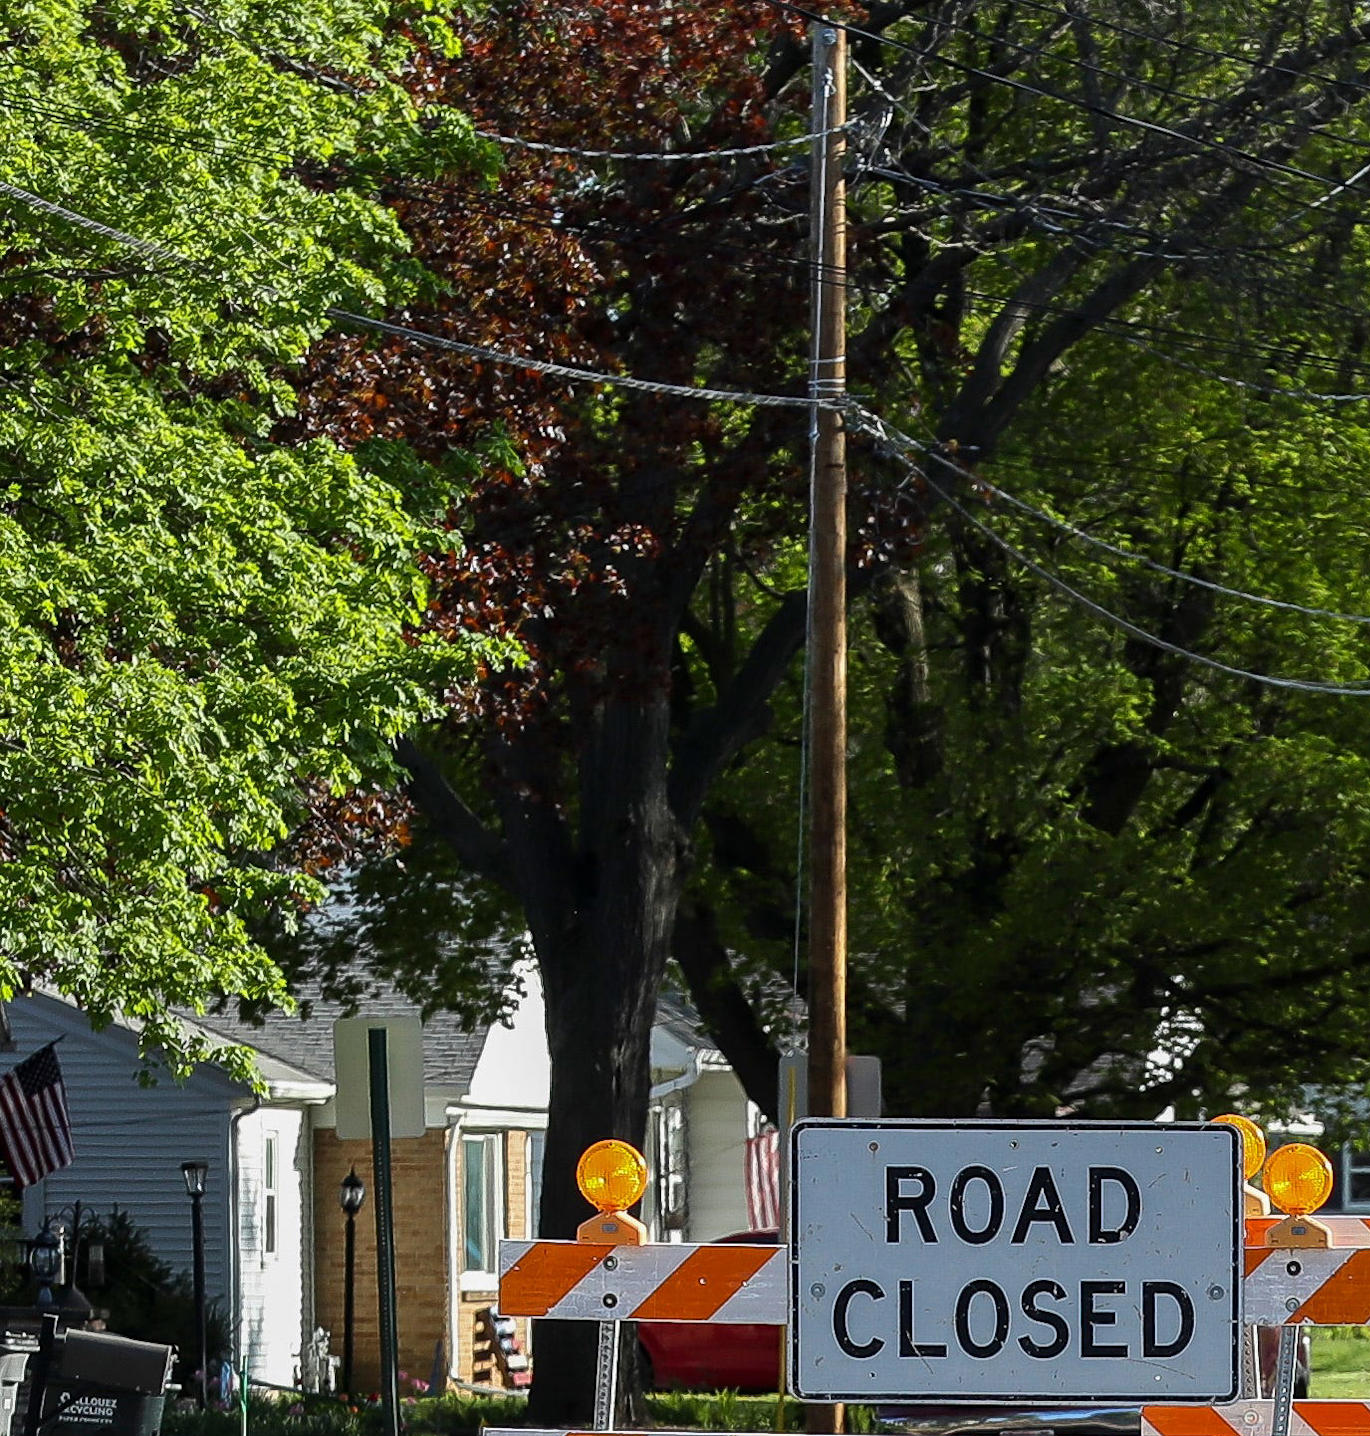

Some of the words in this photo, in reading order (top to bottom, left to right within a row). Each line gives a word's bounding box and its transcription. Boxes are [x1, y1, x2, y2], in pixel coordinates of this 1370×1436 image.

[885, 1165, 1141, 1245] ROAD
[833, 1279, 1196, 1359] CLOSED
[74, 1396, 118, 1409] LLOUEZ
